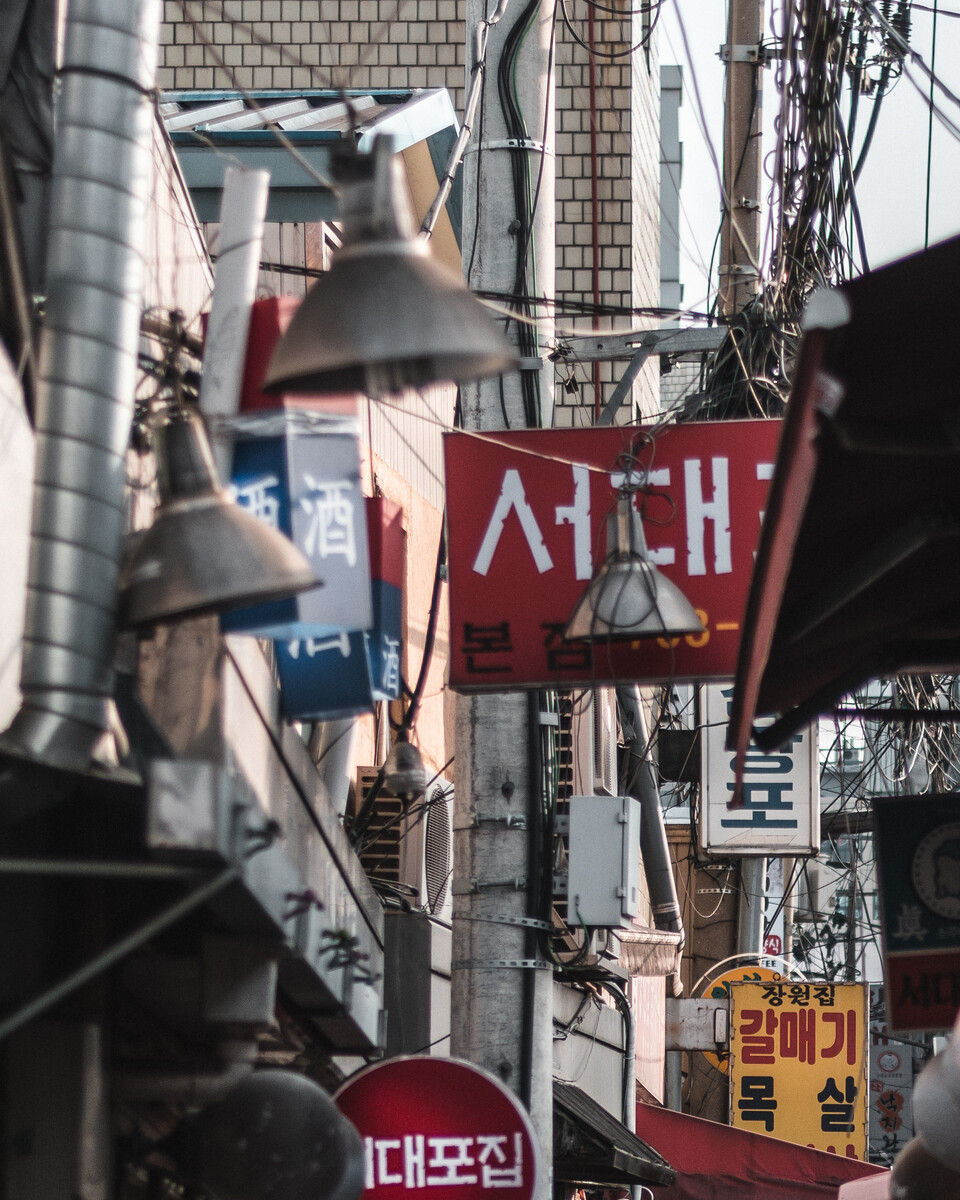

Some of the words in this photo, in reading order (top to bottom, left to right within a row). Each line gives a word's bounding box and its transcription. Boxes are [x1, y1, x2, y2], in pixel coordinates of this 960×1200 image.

[302, 473, 357, 568] 酒
[762, 985, 836, 1007] 장원집
[739, 1009, 857, 1066] 갈매기
